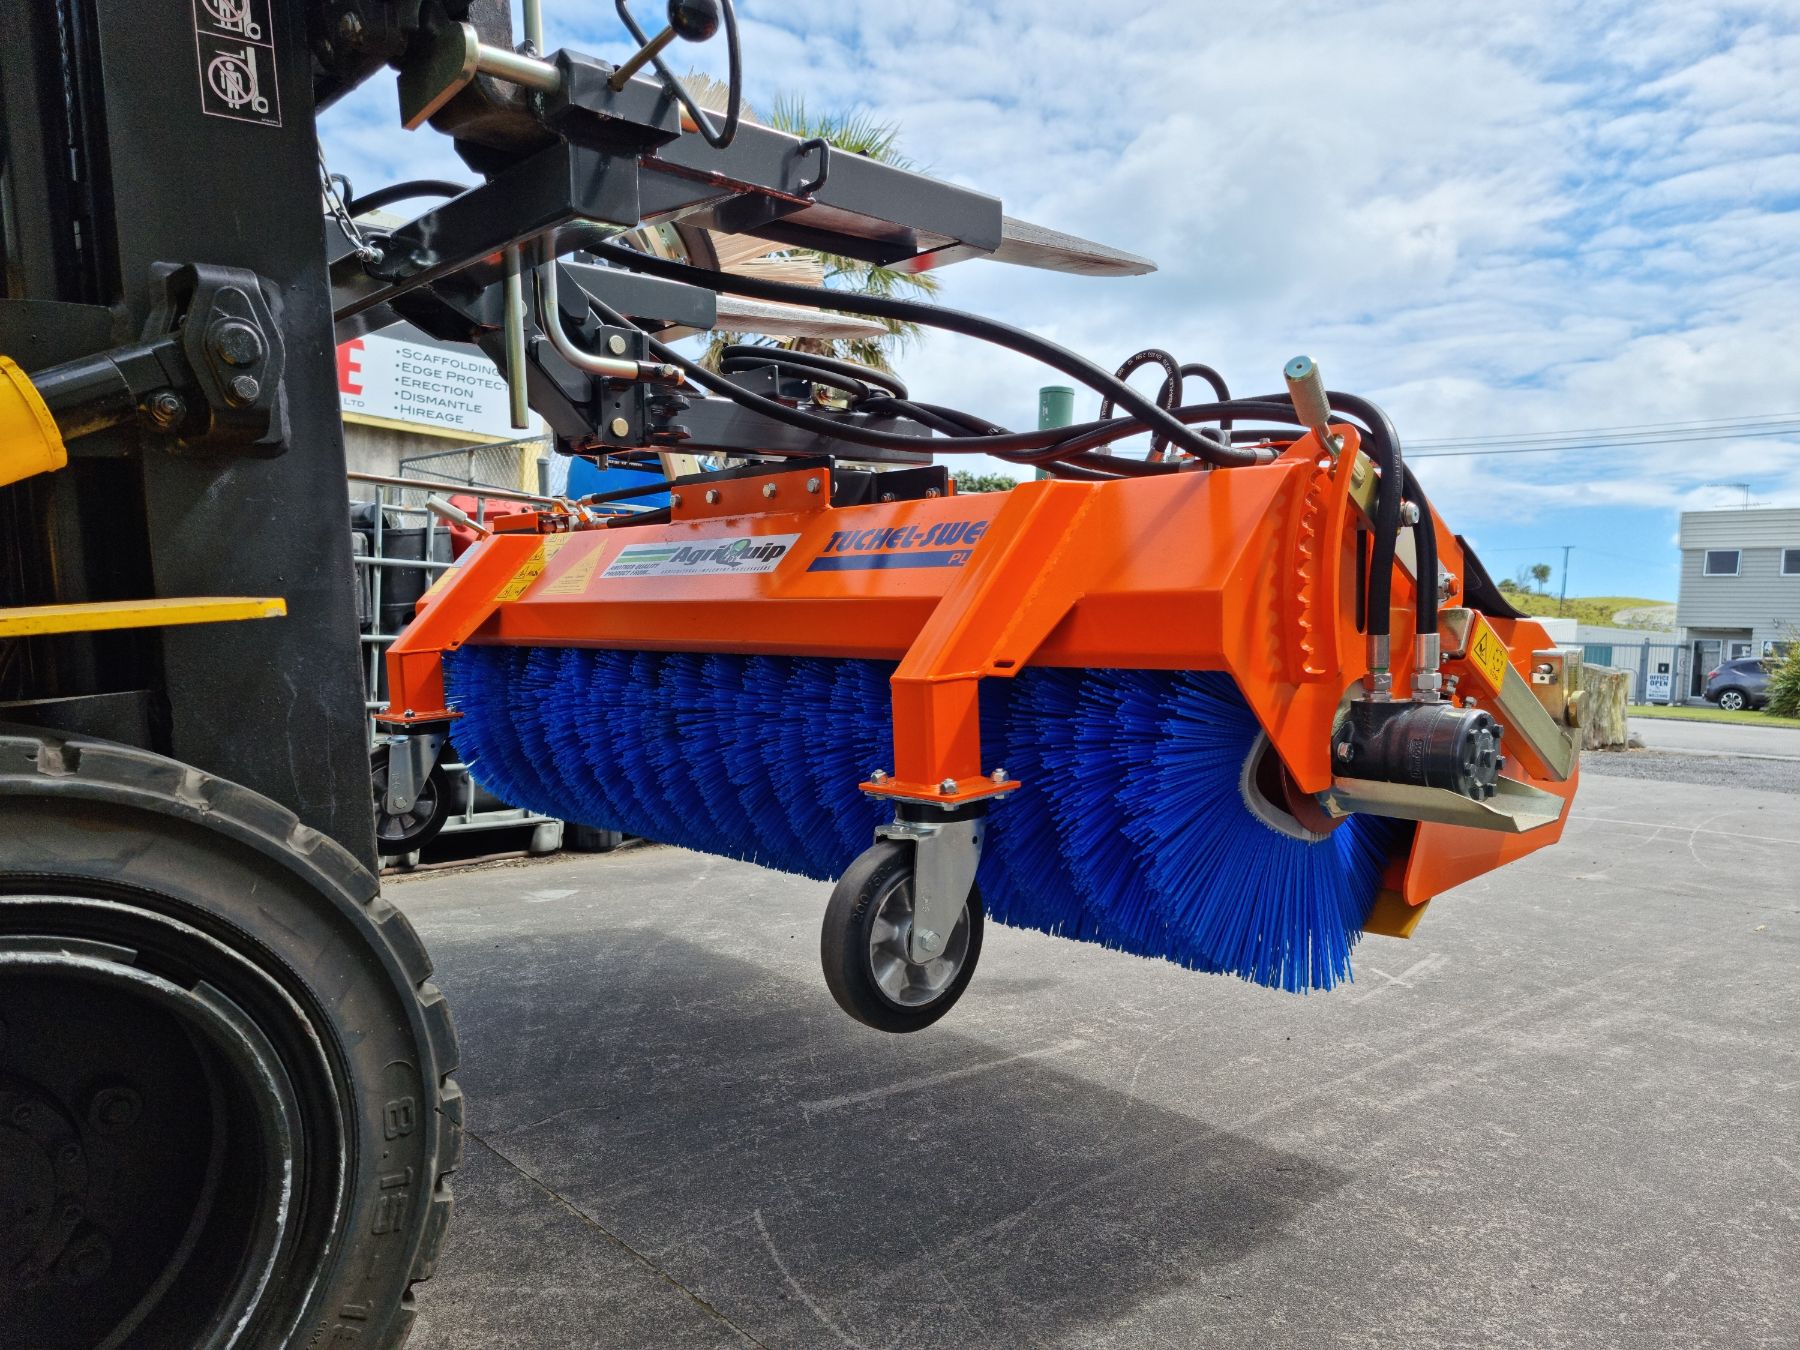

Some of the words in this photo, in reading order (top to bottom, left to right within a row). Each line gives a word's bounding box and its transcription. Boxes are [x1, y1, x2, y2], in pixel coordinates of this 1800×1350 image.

[401, 362, 442, 379] EDGE
[401, 376, 474, 398] ERECTION
[344, 397, 365, 408] LTD
[400, 390, 482, 413] DISMANTLE
[400, 404, 464, 424] HIREAGE
[823, 520, 990, 552] TUCHEL-SWE
